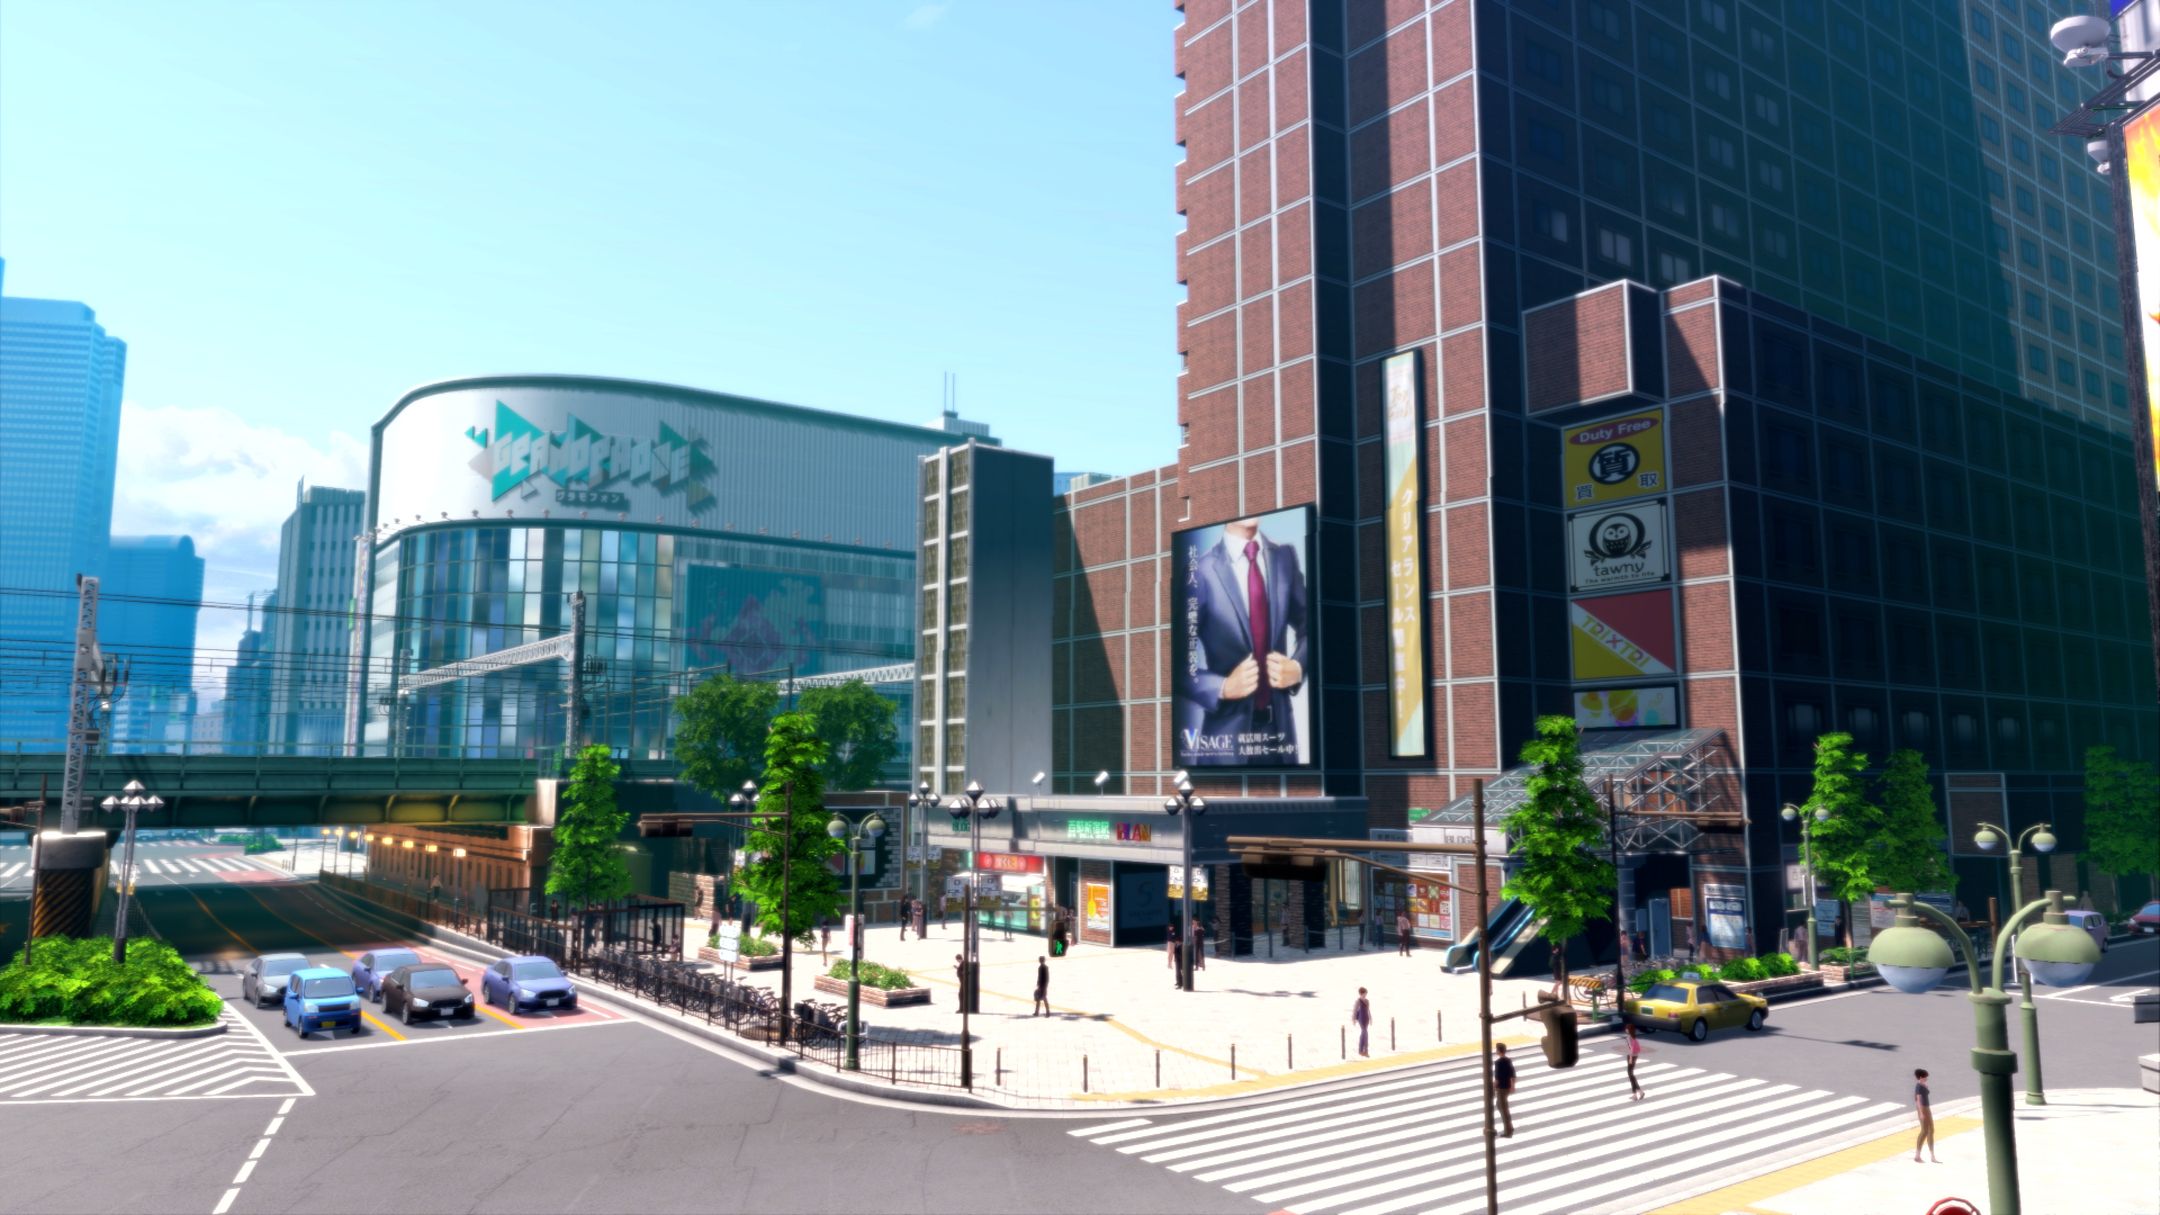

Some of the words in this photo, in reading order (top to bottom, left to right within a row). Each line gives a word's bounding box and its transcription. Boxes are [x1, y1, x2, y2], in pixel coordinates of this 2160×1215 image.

[1579, 428, 1613, 443] Duty
[1618, 420, 1651, 434] Free
[492, 431, 690, 487] GRAMOPHONE
[1597, 449, 1631, 479] 質
[556, 491, 621, 503] グラモフォン
[1577, 484, 1593, 500] 買
[1640, 473, 1657, 488] 取
[1400, 488, 1416, 622] クリアランス
[1593, 562, 1645, 577] tawny
